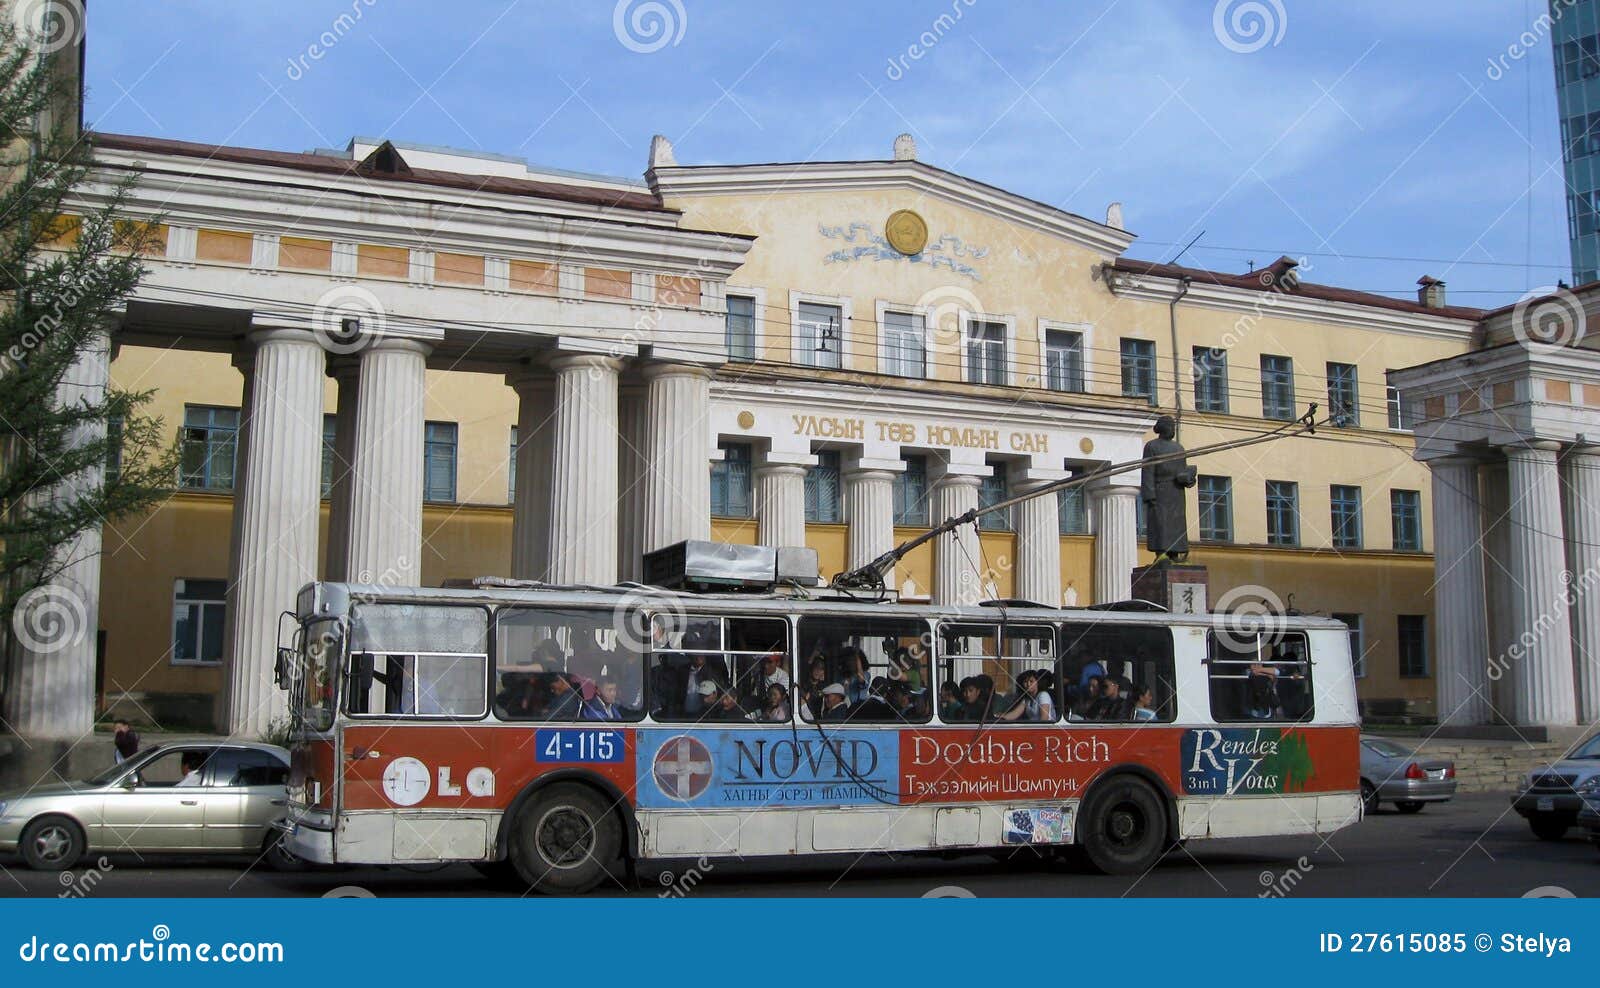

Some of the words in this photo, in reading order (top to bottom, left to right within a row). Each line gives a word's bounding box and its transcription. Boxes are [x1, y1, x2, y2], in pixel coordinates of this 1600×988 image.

[792, 414, 864, 439] УЛСЫН
[875, 420, 916, 443] ТӨВ
[926, 425, 999, 449] НОМЫН
[1010, 432, 1048, 453] САН
[545, 731, 614, 760] 4-115
[734, 740, 878, 779] NOVID
[912, 735, 1033, 766] Double
[1045, 735, 1110, 763] Rich
[1188, 729, 1279, 772] Rendez
[1002, 773, 1079, 797] Шампунь
[1224, 758, 1279, 795] Vous
